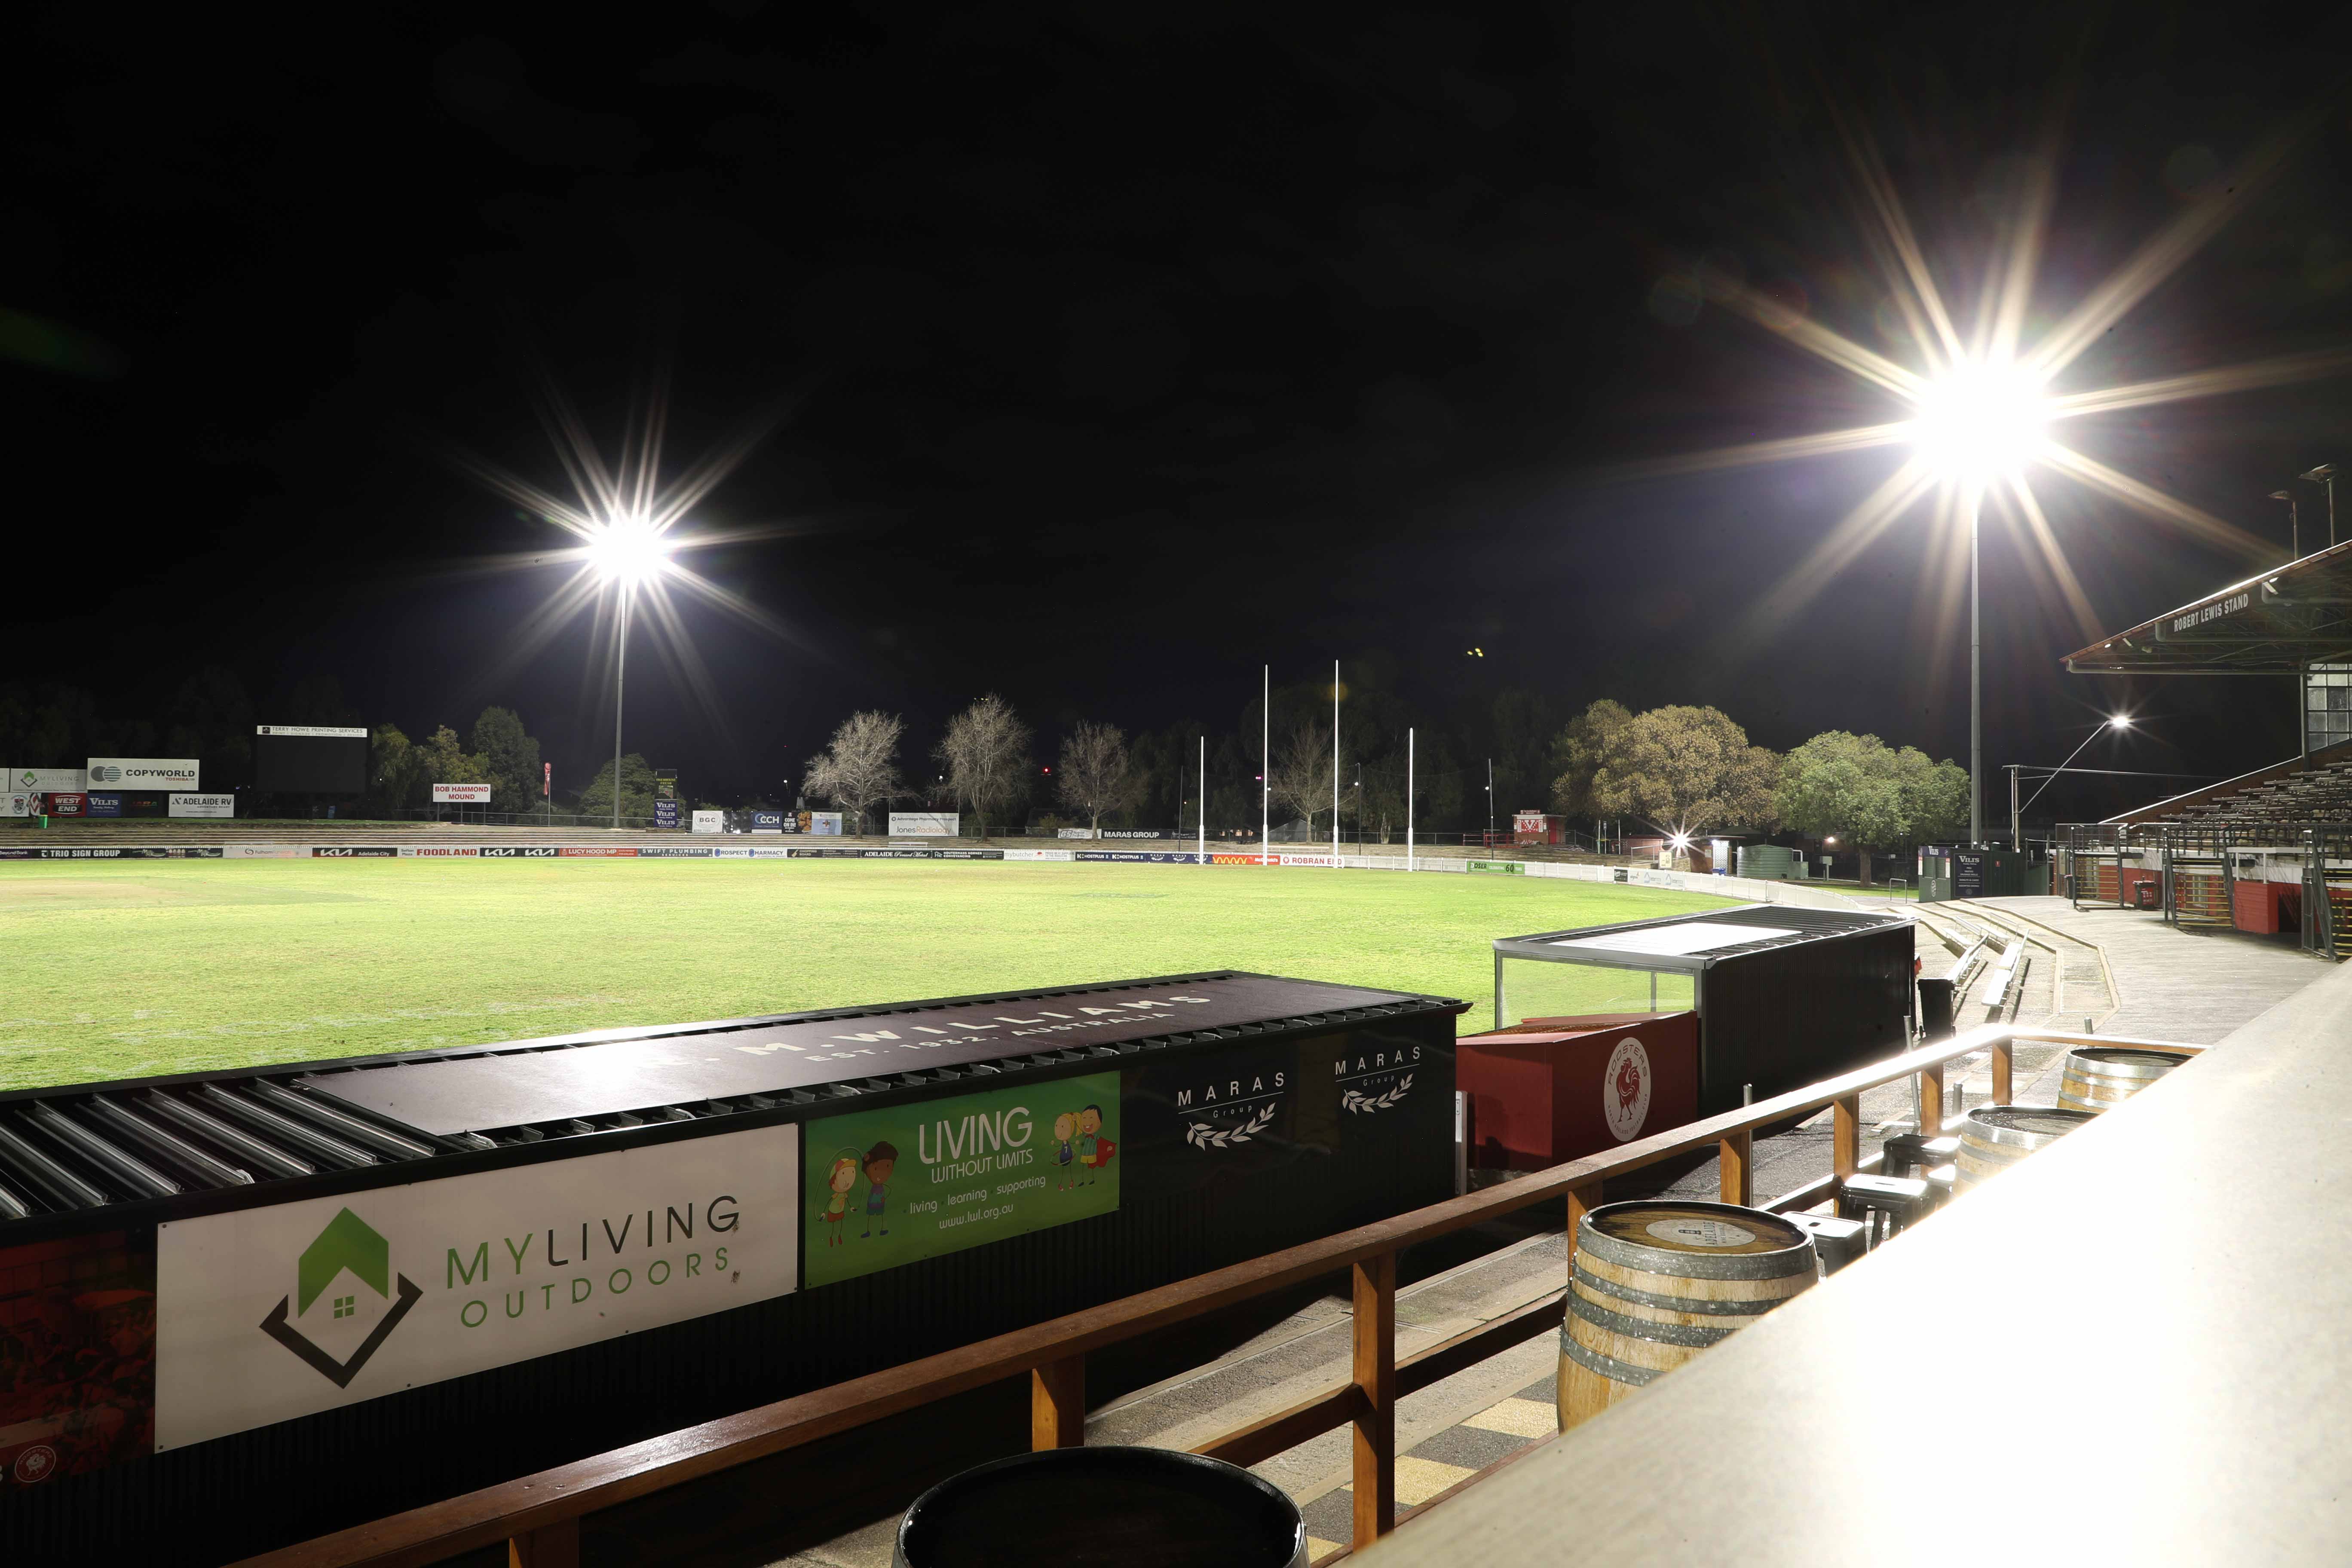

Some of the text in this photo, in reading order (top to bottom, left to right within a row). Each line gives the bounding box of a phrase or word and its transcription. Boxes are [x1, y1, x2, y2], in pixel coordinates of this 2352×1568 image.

[2174, 593, 2248, 632] ROBERT LEWIS STAND
[804, 1049, 890, 1063] EST.
[1012, 1012, 1176, 1037] AUSTRALIA
[1335, 1046, 1420, 1075] MARAS
[1608, 1044, 1648, 1085] ROOSTERS
[1178, 1072, 1284, 1106] MARAS
[1363, 1075, 1395, 1086] Group
[1213, 1104, 1253, 1118] Group
[919, 1107, 1033, 1164] LIVING
[931, 1148, 1033, 1184] WITHOUT LIMITS
[910, 1176, 1046, 1214] living learning supporting
[939, 1204, 1014, 1229] www.lwl.org.au
[461, 1247, 728, 1328] OUTDOORS
